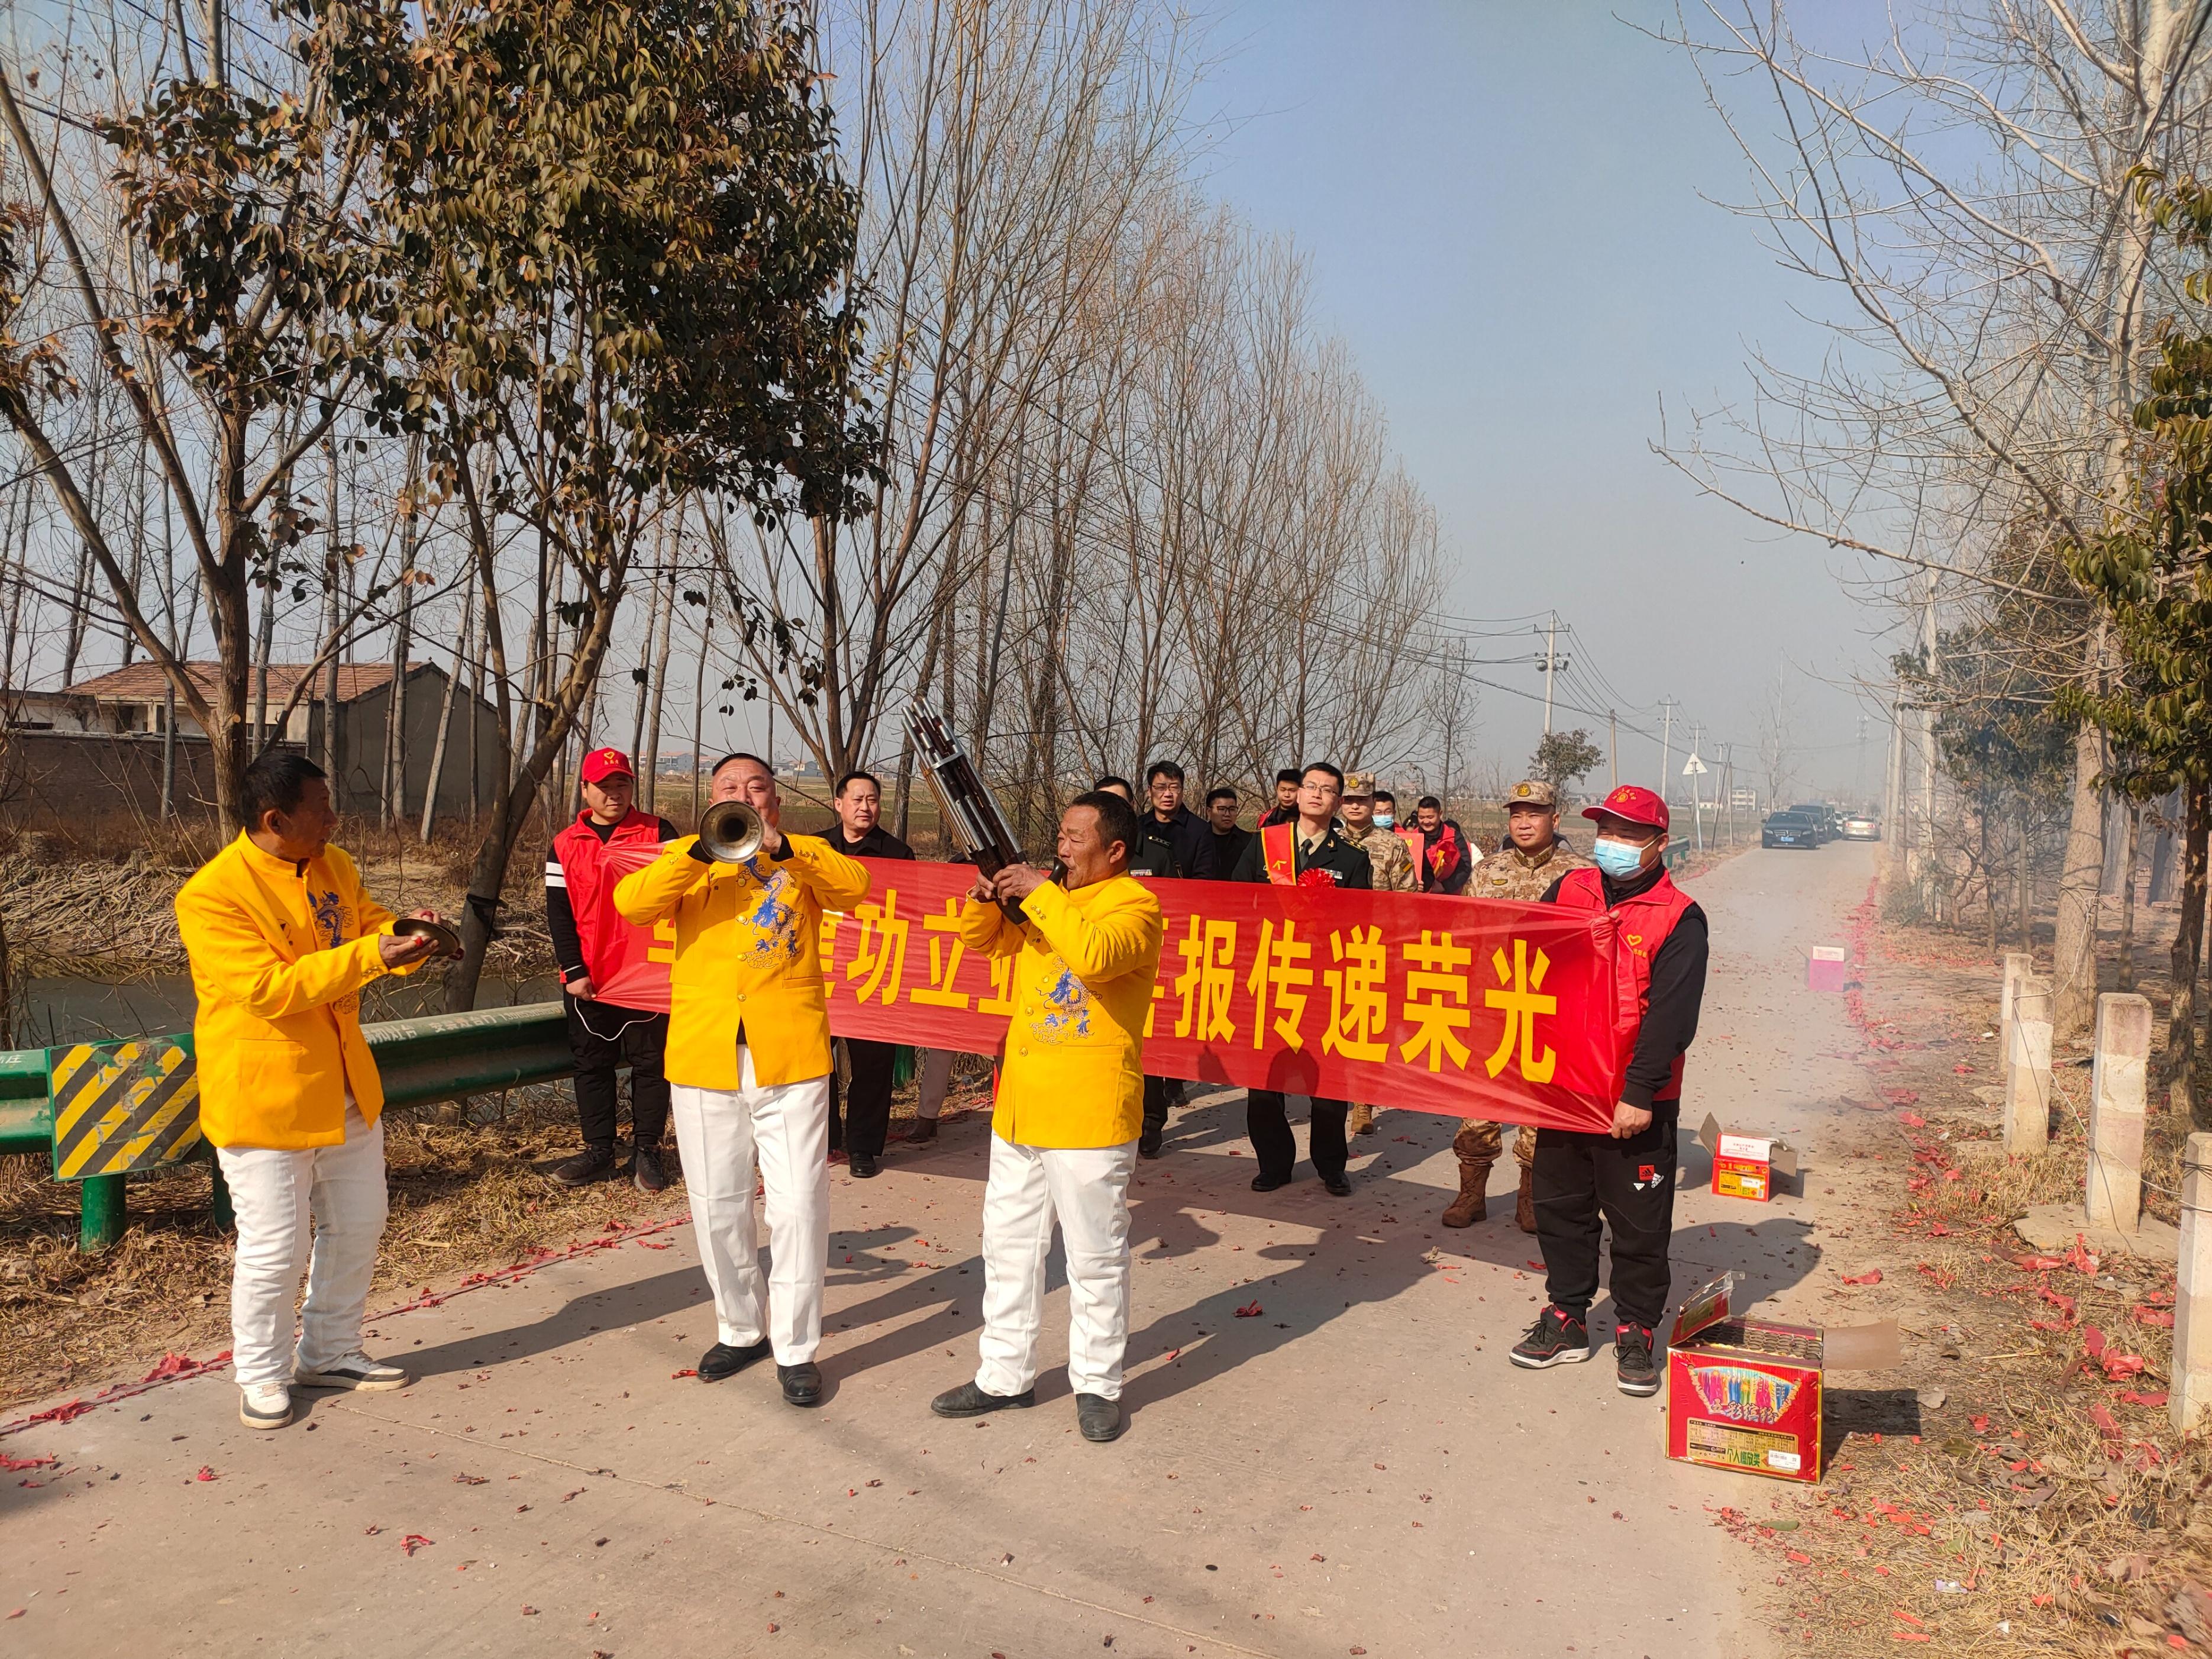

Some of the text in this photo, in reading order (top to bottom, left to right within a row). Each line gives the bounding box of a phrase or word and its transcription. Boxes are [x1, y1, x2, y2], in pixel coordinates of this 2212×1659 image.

[1143, 914, 1557, 1084] 报传递荣光
